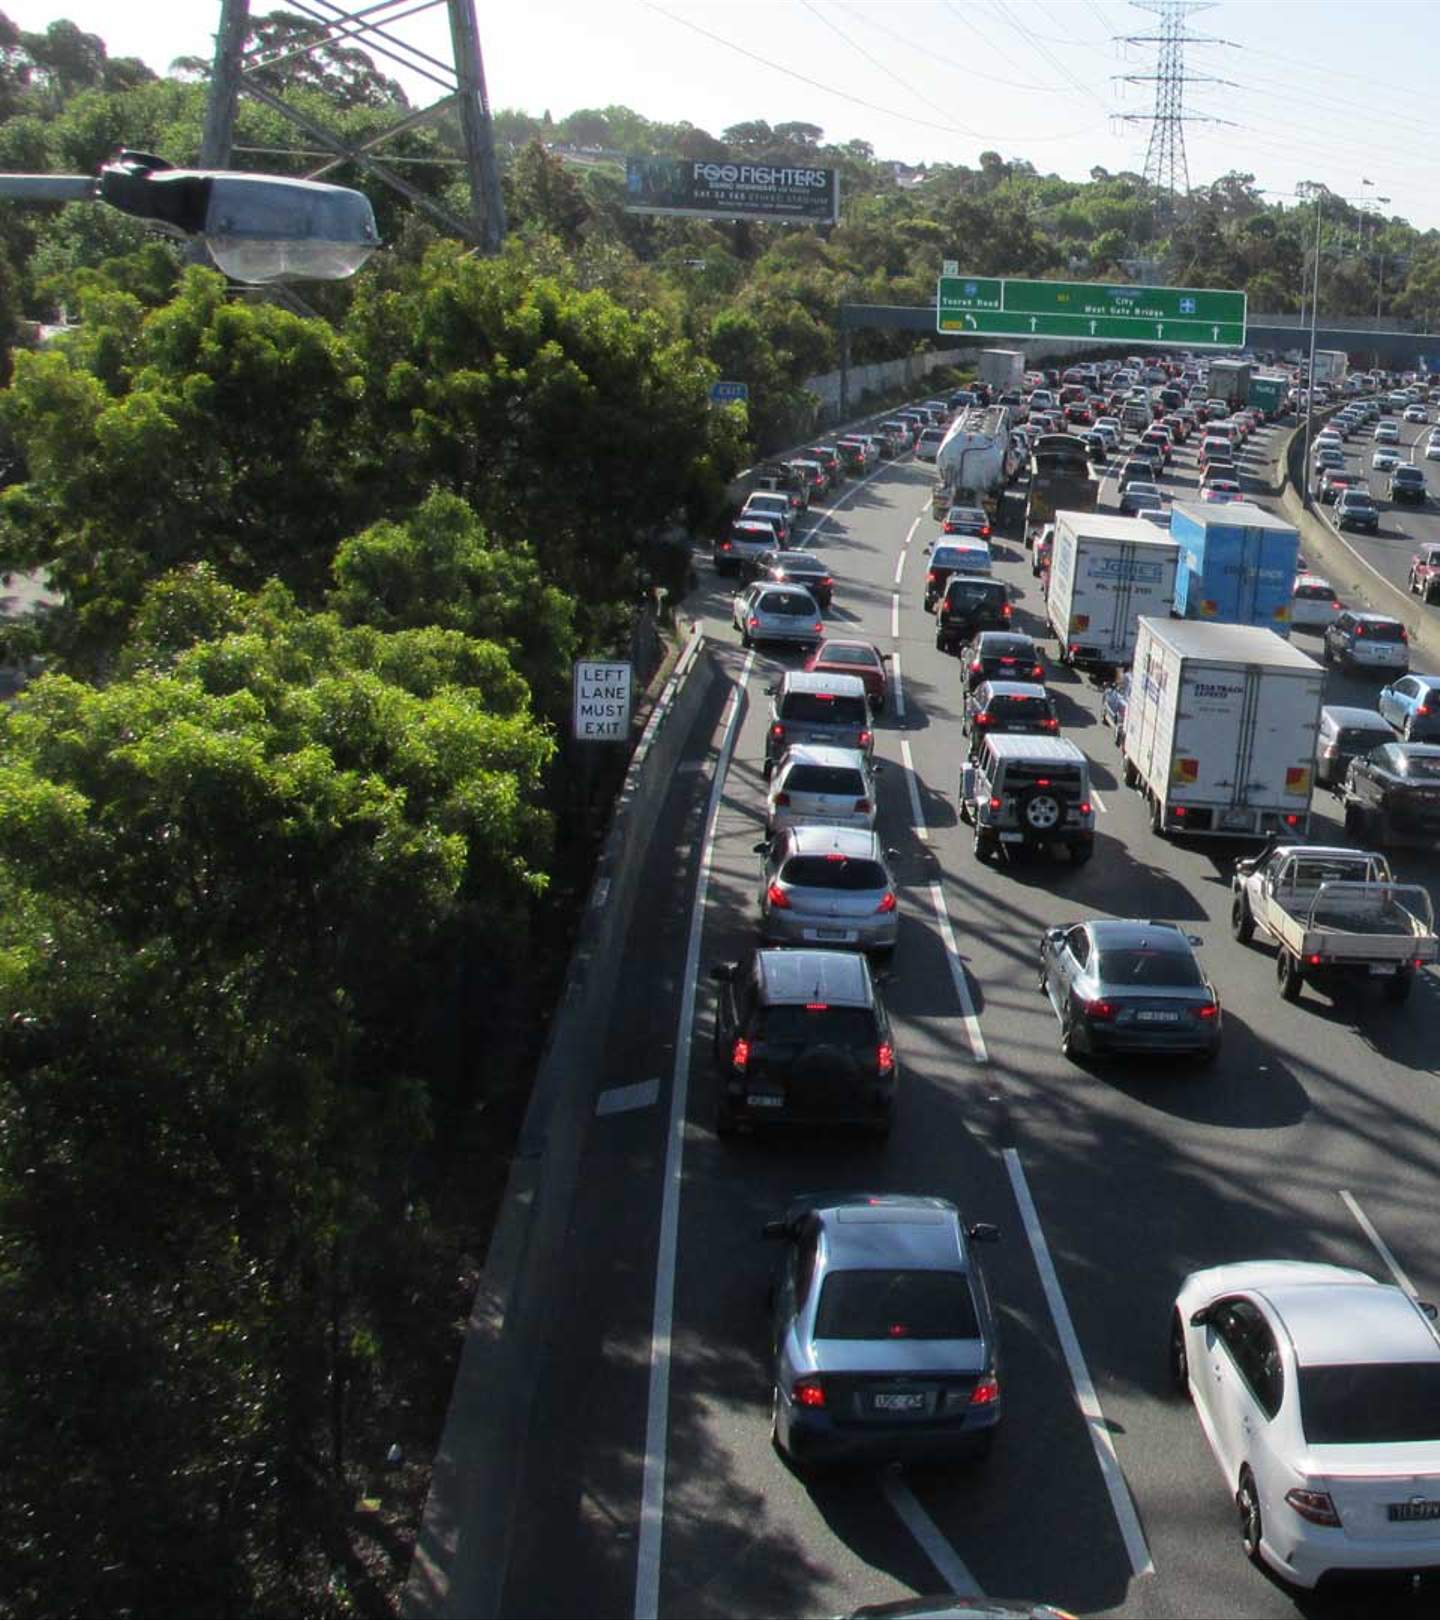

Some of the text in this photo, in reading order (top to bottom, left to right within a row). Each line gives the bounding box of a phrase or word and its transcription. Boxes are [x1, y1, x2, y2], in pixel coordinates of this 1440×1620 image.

[693, 163, 827, 188] FOO FIGHTERS
[1115, 297, 1134, 307] City
[1084, 305, 1164, 318] West Gate Bridge
[584, 669, 625, 681] LEFT
[581, 687, 625, 699] LANE
[581, 704, 625, 717] MUST
[585, 722, 620, 734] EXIT
